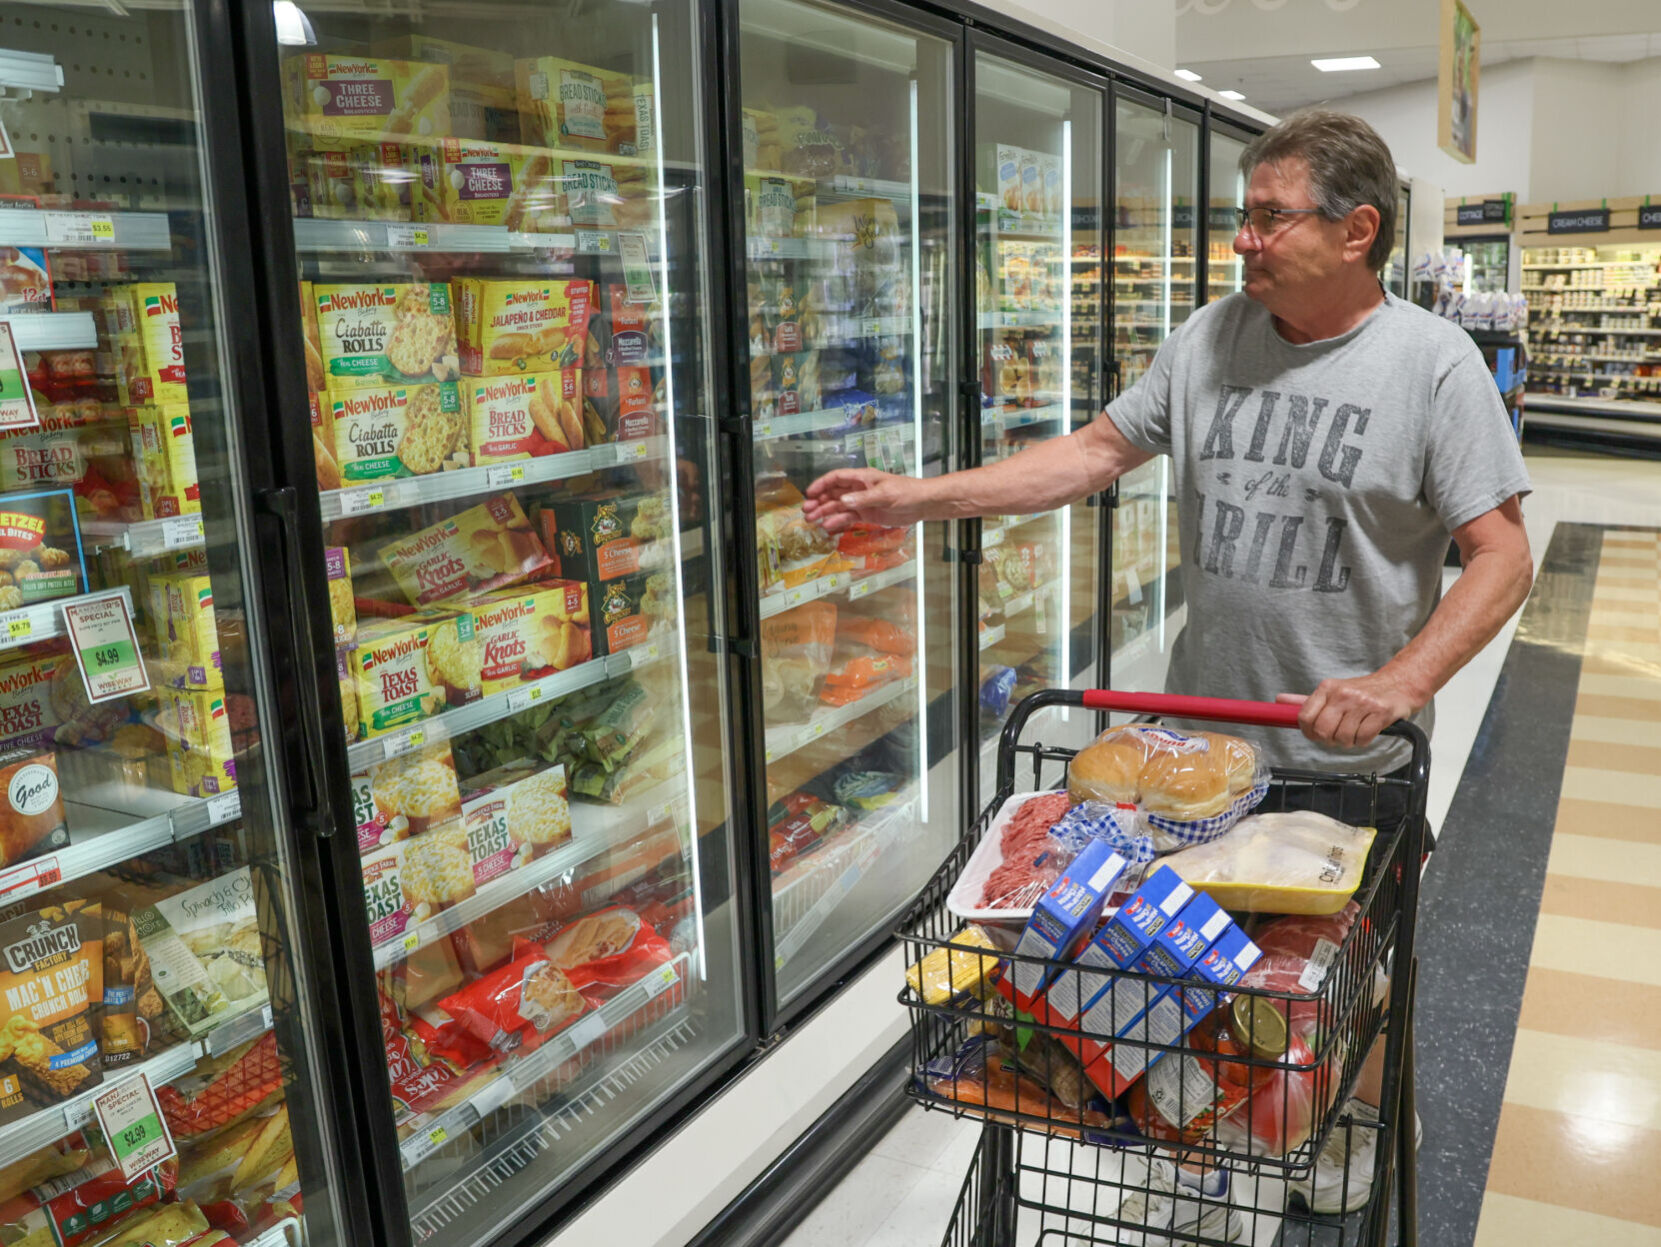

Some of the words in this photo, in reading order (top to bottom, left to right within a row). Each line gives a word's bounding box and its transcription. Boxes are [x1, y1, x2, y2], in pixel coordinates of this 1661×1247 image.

[336, 63, 371, 74] NewYork
[340, 83, 375, 95] THREE
[560, 83, 583, 101] BREAD
[336, 95, 382, 108] CHEESE
[471, 168, 497, 179] THREE
[468, 178, 503, 192] CHEESE
[562, 173, 588, 192] BREAD
[590, 173, 618, 194] STICKS
[1552, 218, 1576, 228] CREAM
[1577, 216, 1604, 226] CHEESE
[331, 288, 385, 310] NewYork
[512, 288, 543, 303] NewYork
[535, 307, 566, 321] CHEDDAR
[335, 317, 387, 338] Ciabatta
[342, 338, 384, 354] ROLLS
[352, 358, 378, 367] CHEESE
[485, 382, 528, 401] NewYork
[344, 391, 397, 416] NewYork
[489, 411, 525, 425] BREAD
[350, 422, 398, 443] Ciabatta
[488, 423, 526, 439] STICKS
[1199, 384, 1372, 489] KING
[16, 447, 73, 466] BREAD
[356, 440, 395, 458] ROLLS
[17, 462, 75, 481] STICKS
[365, 460, 390, 470] CHEESE
[1244, 471, 1273, 500] of
[1266, 474, 1292, 498] the
[396, 527, 450, 561] NewYork
[420, 552, 451, 571] GARLIC
[416, 558, 466, 590] Knots
[439, 580, 463, 595] GARLIC
[79, 610, 115, 624] SPECIAL
[479, 602, 526, 630] NewYork
[337, 624, 345, 634] 8
[490, 630, 520, 645] GARLIC
[619, 623, 641, 636] Cheese
[95, 648, 120, 666] $4.99
[372, 632, 420, 666] NewYork
[484, 638, 526, 666] Knots
[497, 663, 517, 674] GARLIC
[97, 676, 133, 690] WISEWAY
[380, 667, 417, 690] TEXAS
[382, 682, 419, 704] TOAST
[391, 701, 414, 714] CHEESE
[17, 733, 43, 746] CHEESE
[16, 773, 51, 808] Good
[468, 817, 506, 847] TEXAS
[470, 833, 508, 863] TOAST
[482, 854, 504, 874] CHEESE
[372, 919, 398, 939] CHEESE
[9, 926, 79, 968] CRUNCH
[34, 952, 67, 971] FACTORY
[6, 981, 35, 1012] MAC
[31, 995, 66, 1020] CRUNCH
[3, 1078, 13, 1094] 6
[107, 1090, 139, 1110] SPECIAL
[124, 1125, 147, 1148] $2.99
[129, 1147, 160, 1169] WISEWAY
